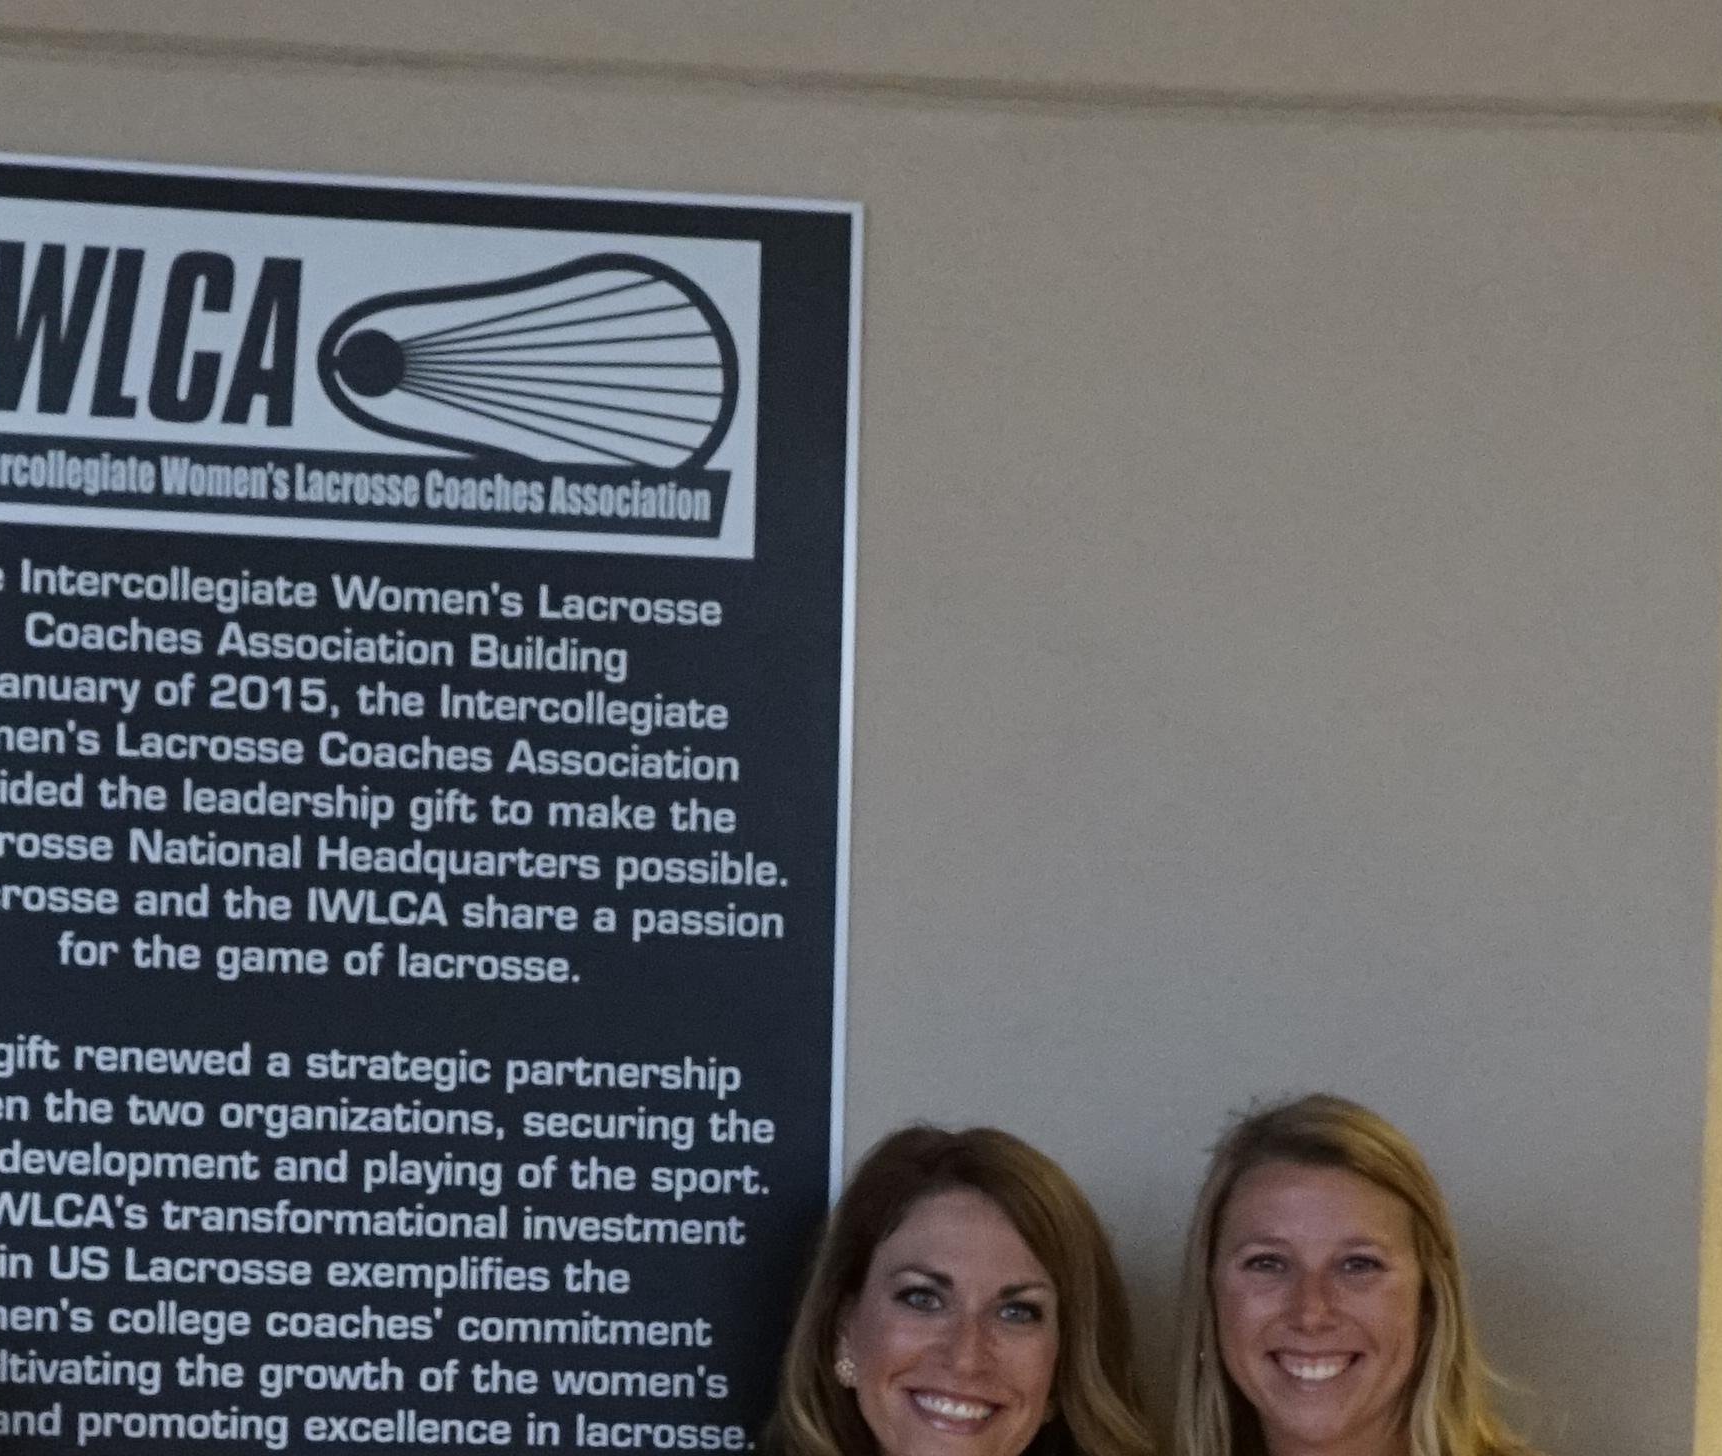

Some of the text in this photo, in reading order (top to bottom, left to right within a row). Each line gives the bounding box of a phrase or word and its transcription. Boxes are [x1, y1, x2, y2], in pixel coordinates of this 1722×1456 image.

[161, 455, 290, 501] Women's
[295, 462, 420, 508] Lacrosse
[424, 468, 545, 514] Coaches
[549, 475, 711, 522] Association
[20, 558, 318, 614] Intercollegiate
[331, 574, 524, 618] Women's
[538, 583, 723, 627] Lacrosse
[24, 611, 628, 684] Coaches Association Building
[154, 672, 196, 707] of
[209, 673, 340, 719] 2015,
[356, 680, 425, 718] the
[440, 683, 729, 737] Intercollegiate
[116, 721, 305, 765] Lacrosse
[318, 730, 493, 773] Coaches
[506, 739, 740, 782] Association
[98, 774, 167, 812] the
[183, 777, 395, 830] leadership
[409, 787, 478, 832] gift
[490, 794, 533, 826] to
[548, 794, 656, 831] make
[669, 797, 737, 834] the
[129, 827, 302, 869] National
[317, 835, 601, 884] Headquarters
[615, 850, 788, 891] possible.
[134, 883, 210, 918] and
[223, 885, 292, 921] the
[307, 887, 449, 927] IWLCA
[462, 893, 579, 932] share
[593, 907, 617, 933] a
[632, 902, 784, 943] passion
[57, 930, 580, 983] for the game of lacrosse.
[74, 1041, 252, 1077] renewed
[266, 1051, 291, 1078] a
[306, 1048, 491, 1092] strategic
[505, 1055, 742, 1101] partnership
[43, 1088, 114, 1125] the
[126, 1094, 205, 1127] two
[219, 1096, 505, 1141] organizations,
[523, 1105, 695, 1151] securing
[708, 1108, 775, 1144] the
[274, 1148, 348, 1184] and
[363, 1149, 503, 1197] playing
[517, 1154, 558, 1189] of
[569, 1155, 637, 1191] the
[651, 1165, 769, 1202] sport.
[161, 1199, 508, 1239] transformational
[523, 1205, 746, 1245] investment
[49, 1244, 110, 1281] US
[125, 1246, 312, 1286] Lacrosse
[327, 1255, 551, 1299] exemplifies
[563, 1258, 631, 1294] the
[108, 1299, 251, 1346] college
[265, 1304, 443, 1341] coaches'
[457, 1310, 712, 1347] commitment
[175, 1353, 245, 1389] the
[259, 1356, 404, 1399] growth
[419, 1358, 460, 1393] of
[471, 1359, 539, 1395] the
[552, 1365, 728, 1398] women's
[77, 1405, 289, 1451] promoting
[304, 1409, 512, 1446] excellence
[526, 1410, 561, 1446] in
[576, 1413, 756, 1450] lacrosse.
